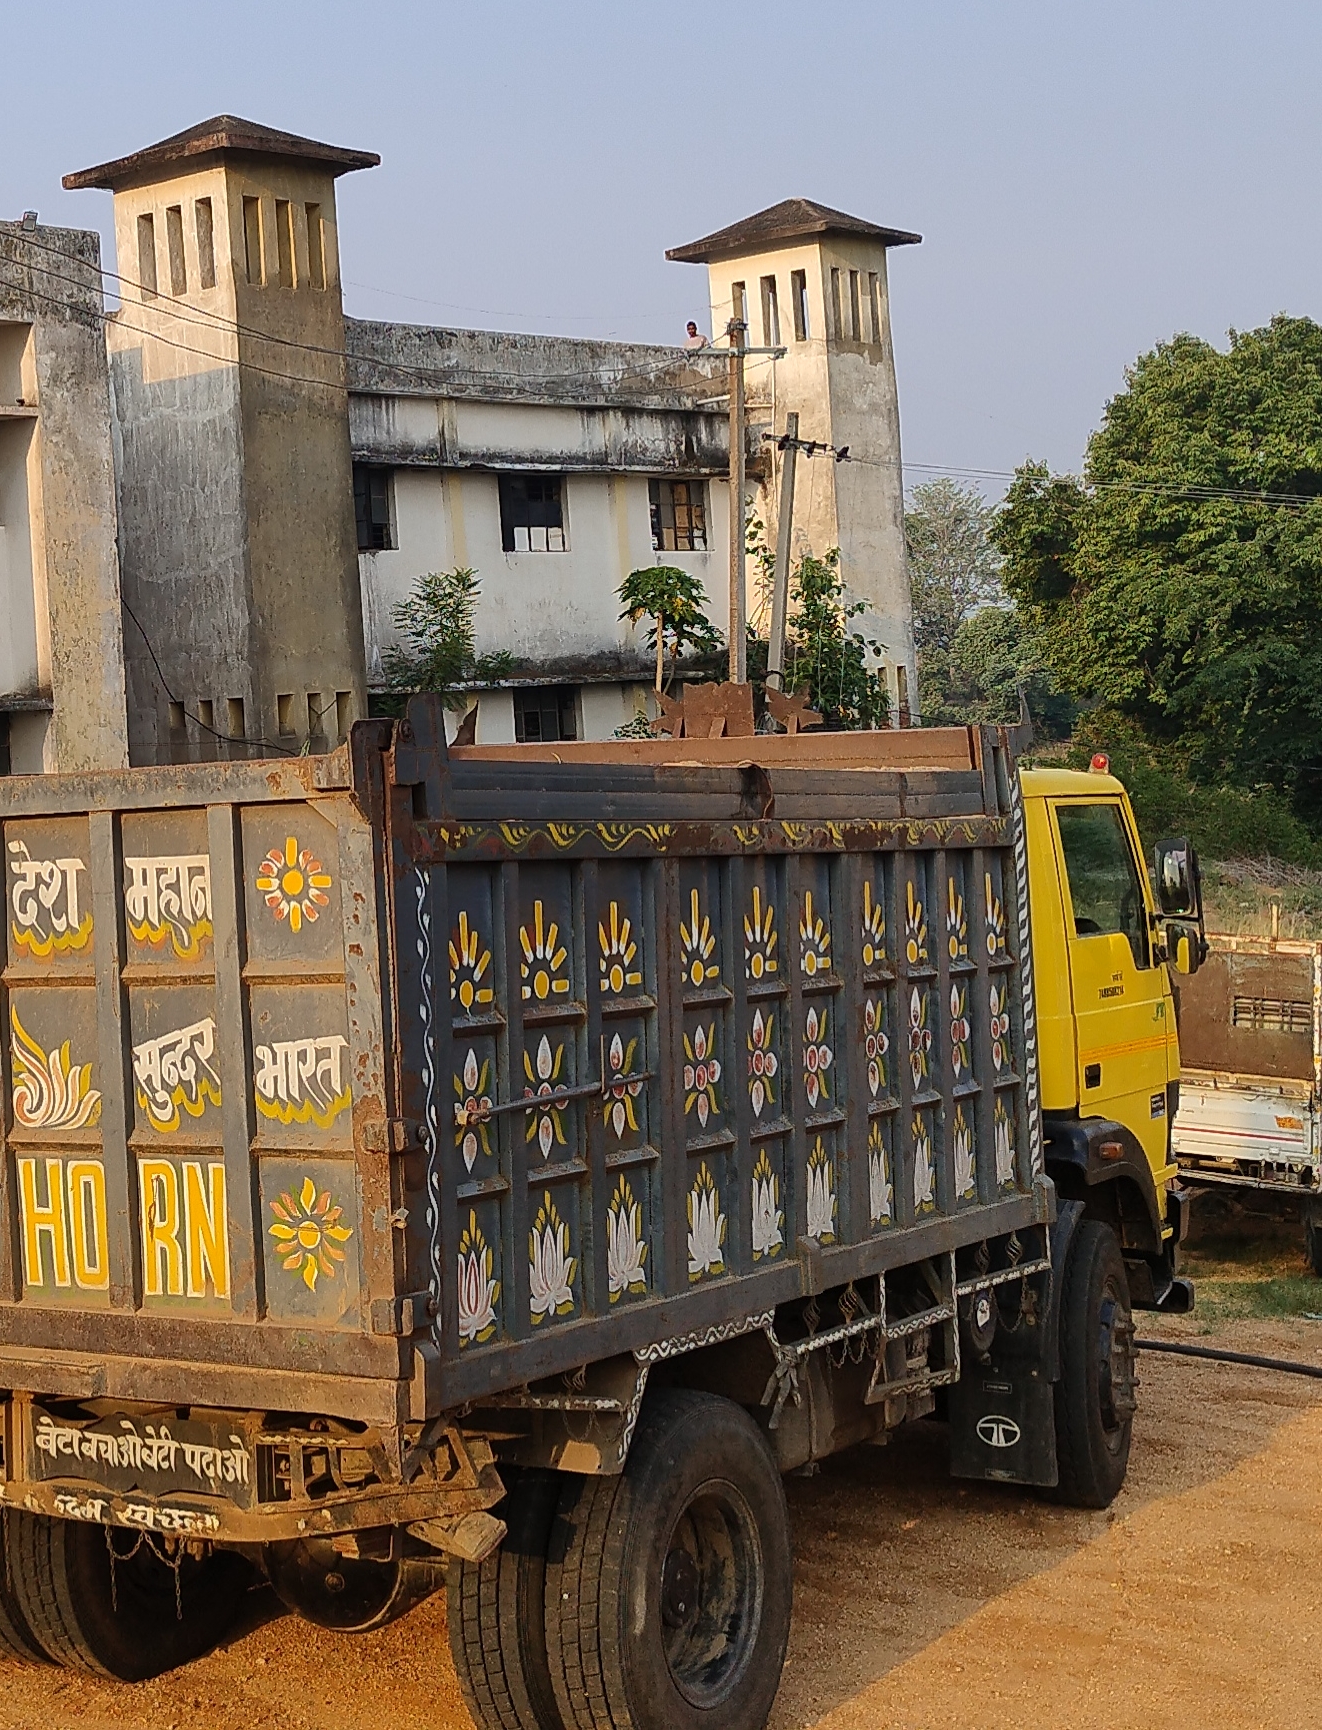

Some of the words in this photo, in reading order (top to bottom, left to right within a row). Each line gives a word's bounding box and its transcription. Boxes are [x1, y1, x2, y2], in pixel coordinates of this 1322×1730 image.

[7, 839, 87, 939] देश
[124, 854, 212, 946] महान
[132, 1017, 221, 1122] सुन्दर
[255, 1035, 350, 1110] भारत
